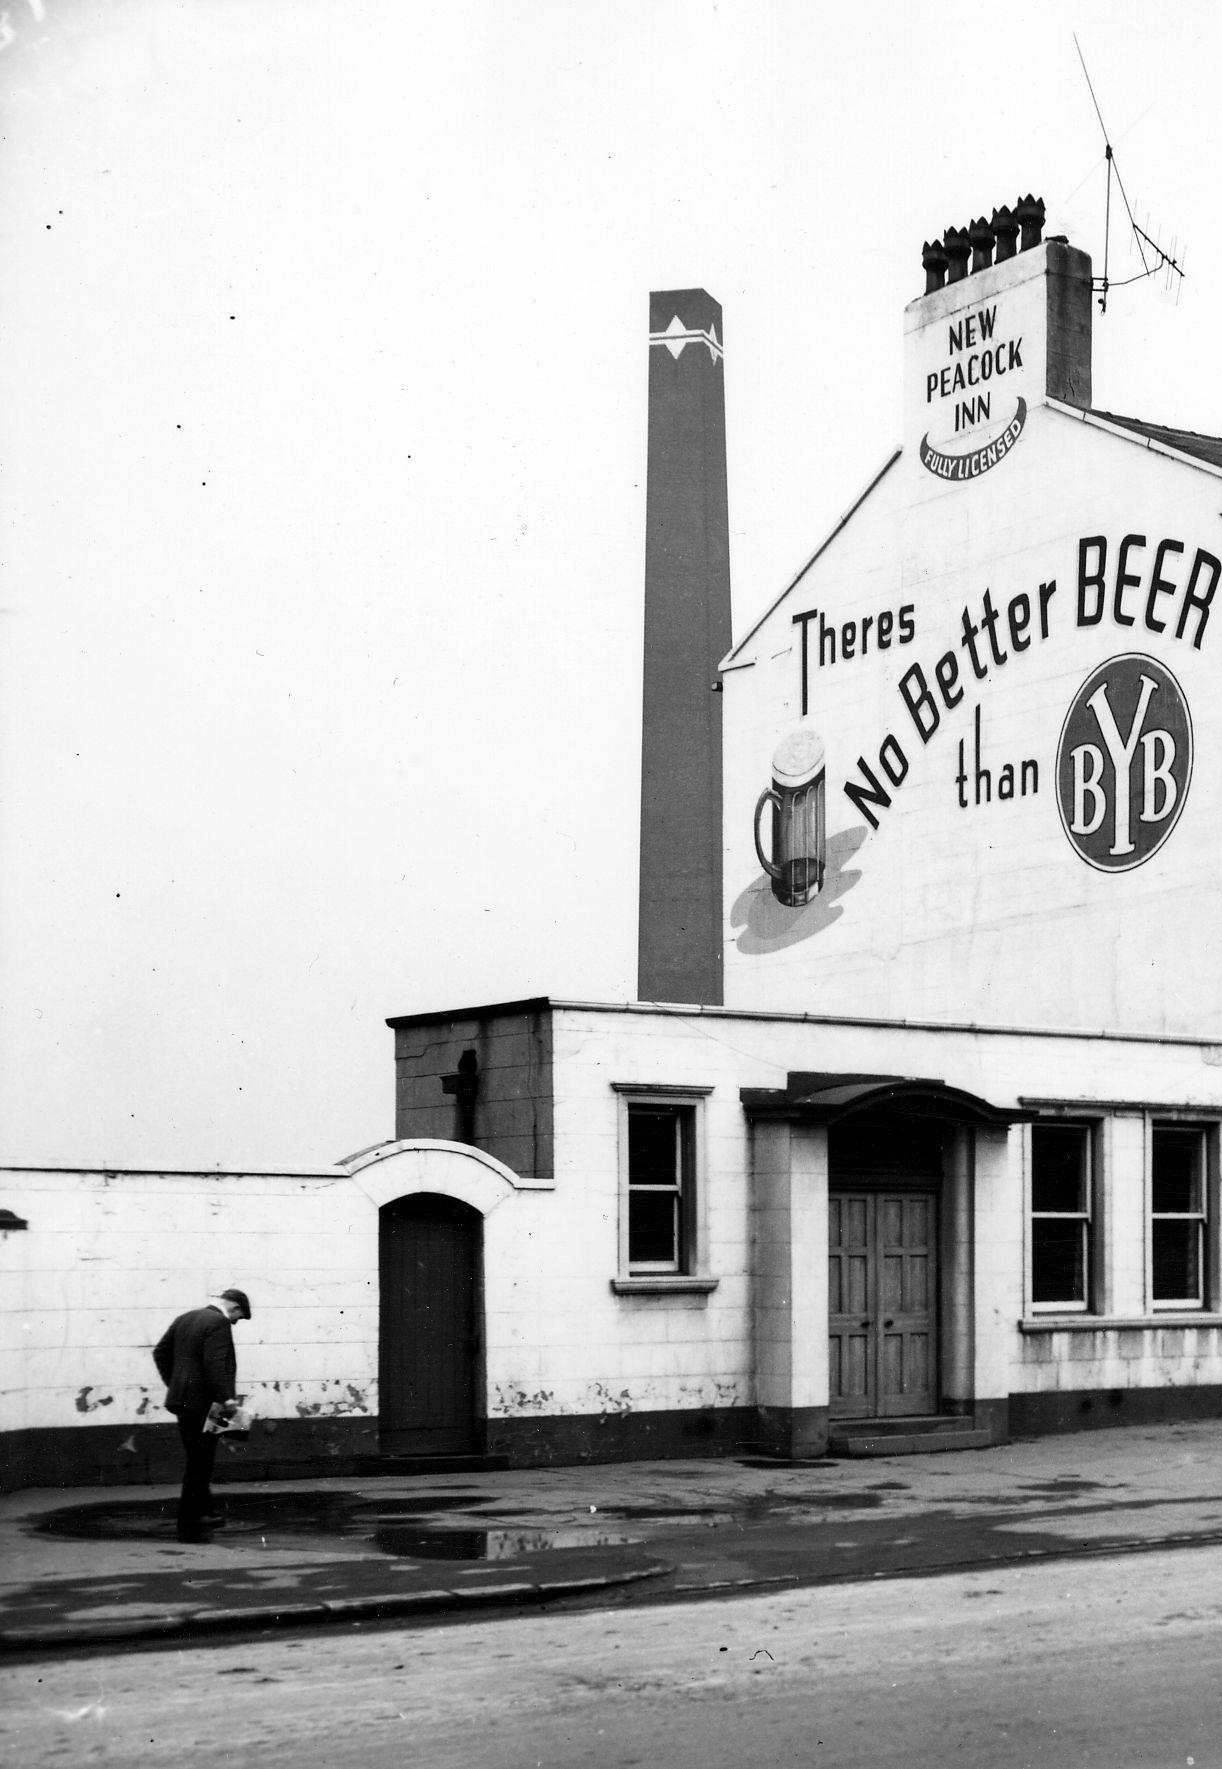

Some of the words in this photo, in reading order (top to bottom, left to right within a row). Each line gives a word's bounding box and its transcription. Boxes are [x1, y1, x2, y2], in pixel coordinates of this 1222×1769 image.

[926, 337, 1023, 404] PEACOCK
[949, 305, 997, 356] NEW
[924, 449, 958, 478] FULLY
[957, 418, 1021, 479] LICENSED
[954, 391, 991, 432] INN
[791, 604, 915, 717] Theres
[843, 733, 909, 831] No
[898, 587, 1057, 745] Better
[1076, 533, 1222, 651] BEER
[955, 703, 1039, 809] than
[1070, 674, 1177, 855] BYB
